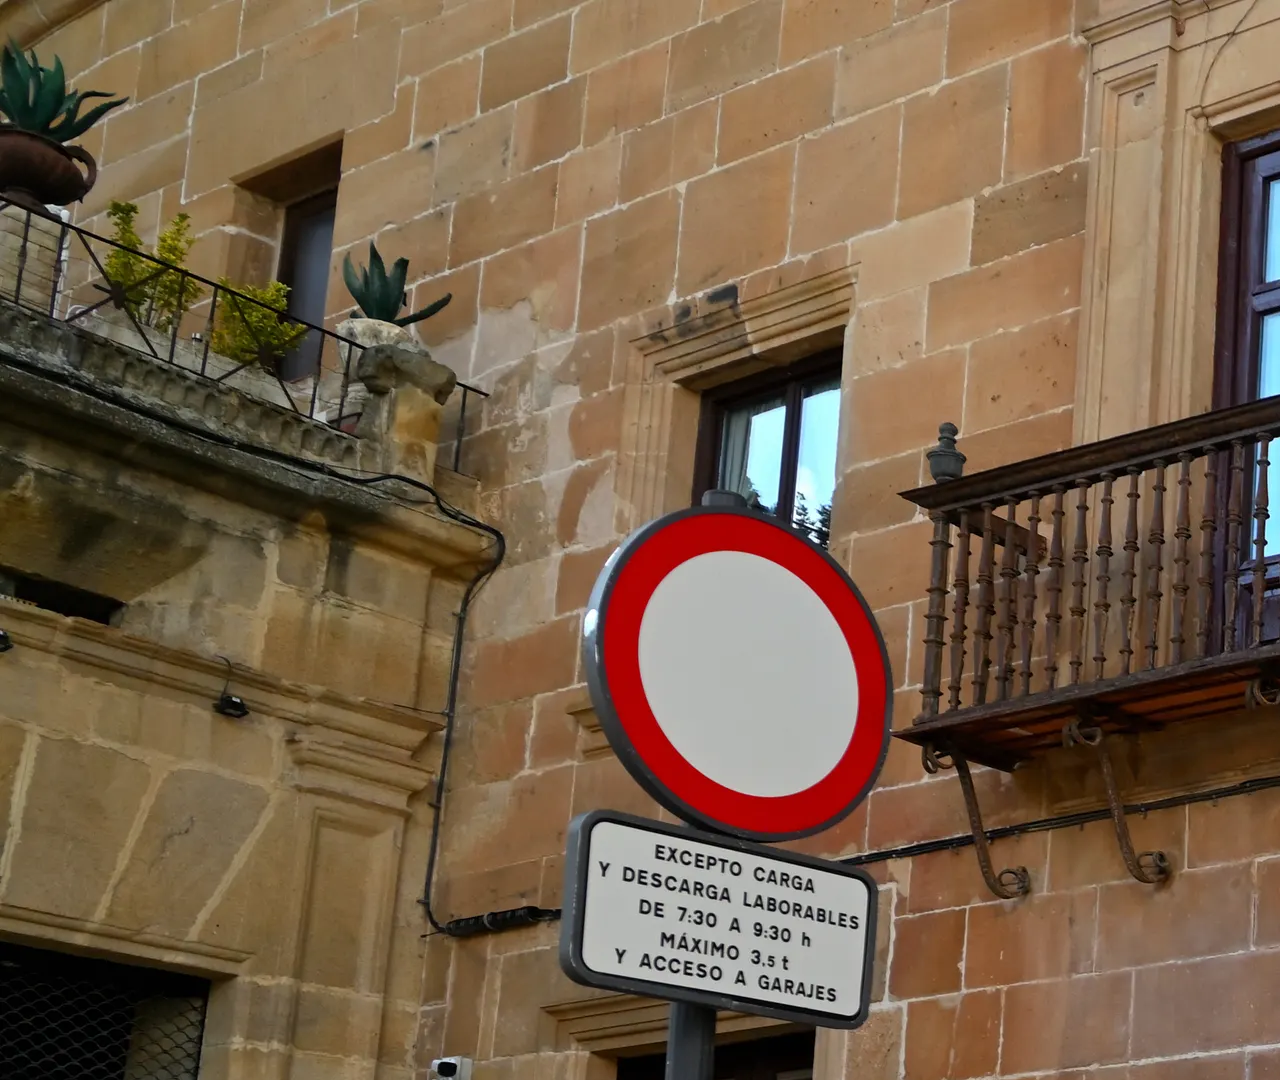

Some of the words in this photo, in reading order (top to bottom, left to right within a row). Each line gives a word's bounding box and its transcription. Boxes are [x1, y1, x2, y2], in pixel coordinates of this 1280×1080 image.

[654, 844, 742, 877] EXCEPTO
[753, 866, 815, 894] CARGA
[598, 860, 611, 878] Y
[622, 866, 732, 904] DESCARGA
[742, 891, 859, 930] LABORABLES
[638, 898, 665, 919] DE
[677, 906, 718, 928] 7:30
[728, 917, 741, 934] A
[753, 921, 792, 943] 9:30
[801, 931, 812, 948] h
[614, 947, 627, 964] Y
[638, 953, 723, 982] ACCESO
[734, 970, 747, 988] A
[757, 974, 837, 1003] GARAJES
[660, 931, 740, 961] MÁXIMO
[781, 955, 789, 971] t
